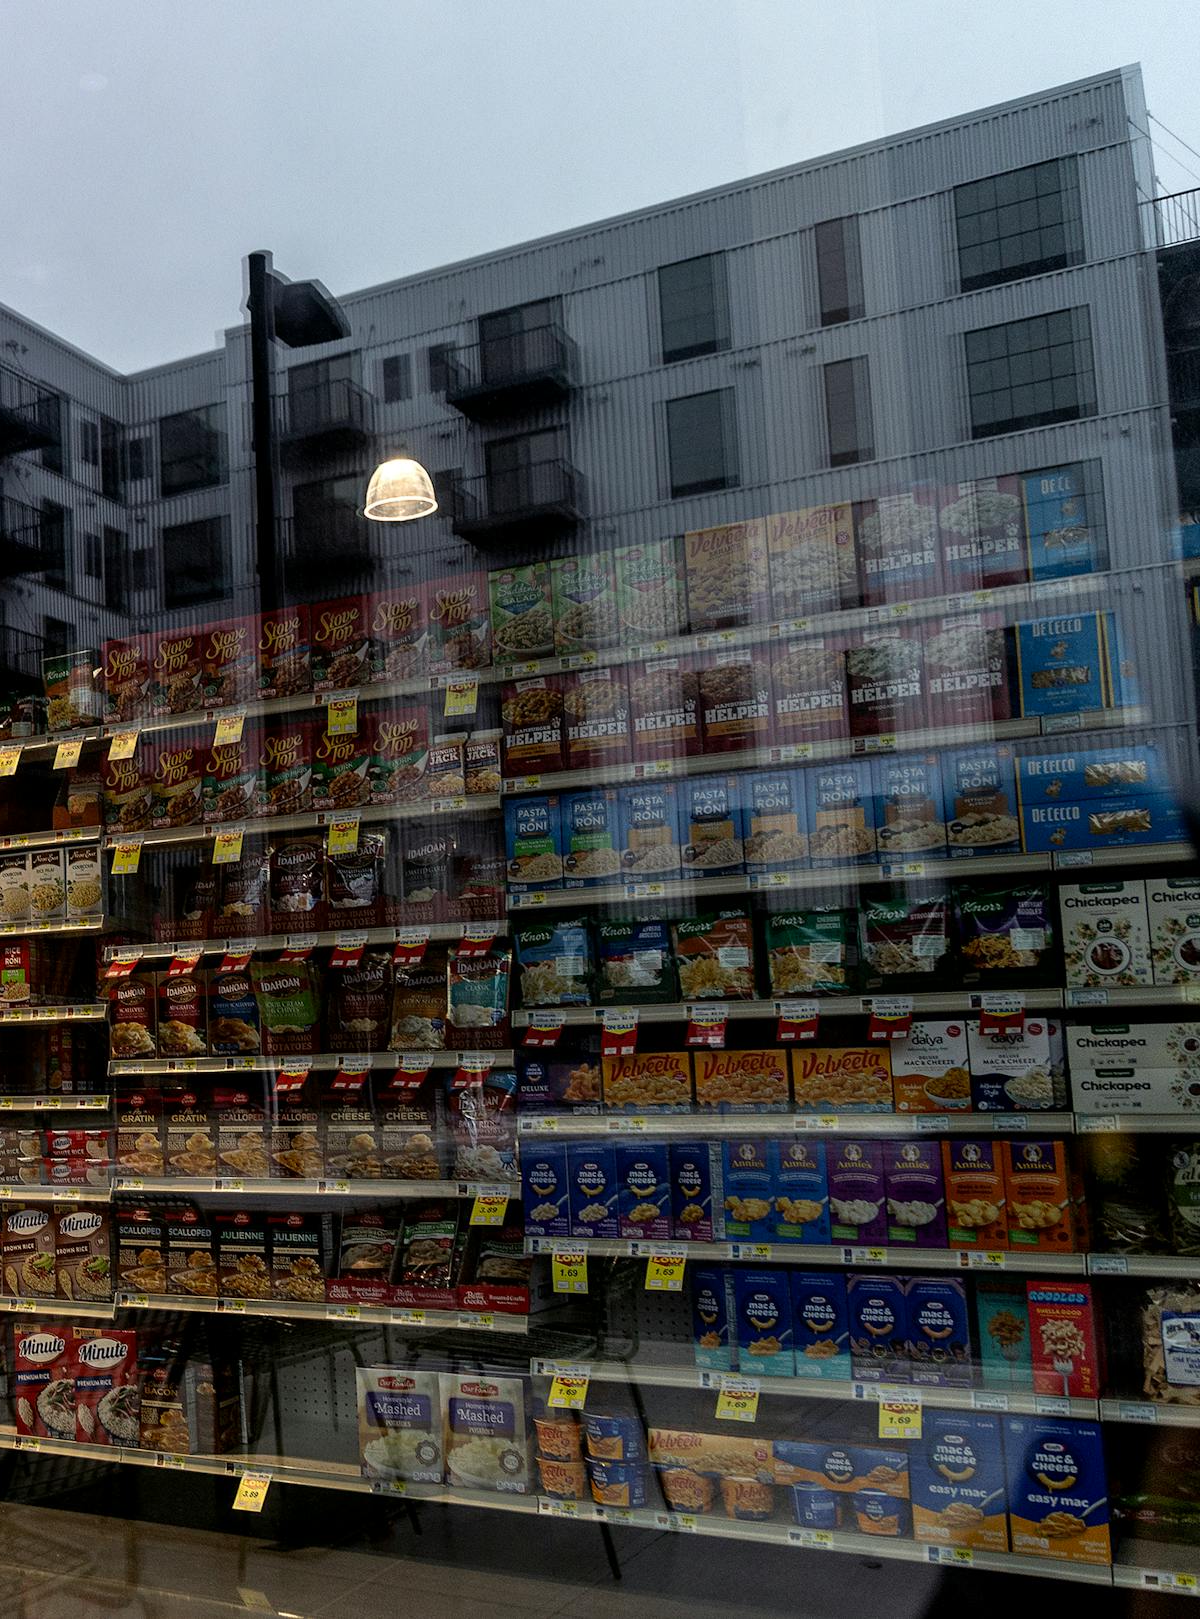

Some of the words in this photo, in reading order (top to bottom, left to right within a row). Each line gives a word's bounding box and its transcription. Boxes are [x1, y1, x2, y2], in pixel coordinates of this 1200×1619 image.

[373, 597, 418, 632] Stove
[315, 607, 360, 642] Stove
[390, 613, 412, 636] Top
[259, 616, 301, 651] Stove
[330, 624, 353, 645] Top
[206, 628, 248, 659] Stove
[274, 633, 295, 654] Top
[154, 637, 194, 669] Stove
[221, 644, 241, 664] Top
[168, 653, 187, 674] Top
[929, 672, 1003, 693] HELPER
[852, 683, 921, 704] HELPER
[776, 694, 843, 714] HELPER
[704, 703, 768, 723] HELPER
[373, 718, 420, 751] Stove
[506, 730, 561, 747] HELPER
[568, 722, 627, 739] HELPER
[260, 734, 303, 765] Stove
[390, 735, 414, 756] Top
[275, 752, 297, 769] Top
[430, 752, 460, 765] JACK
[466, 749, 496, 761] JACK
[155, 749, 194, 779] Stove
[960, 760, 996, 772] PASTA
[169, 765, 188, 784] Top
[694, 788, 725, 801] PASTA
[518, 807, 546, 818] PASTA
[574, 802, 604, 812] PASTA
[277, 851, 317, 866] IDAHOAN
[961, 901, 1004, 915] Knorr
[1064, 895, 1139, 909] Chickapea
[769, 913, 806, 928] Knorr
[866, 908, 907, 923] Knorr
[601, 925, 633, 937] Knorr
[677, 920, 713, 935] Knorr
[520, 931, 552, 943] Knorr
[457, 958, 501, 974] IDAHOAN
[167, 985, 197, 997] IDAHOAN
[261, 977, 300, 992] IDAHOAN
[912, 1035, 943, 1046] daiya
[1077, 1038, 1146, 1049] Chickapea
[610, 1055, 680, 1082] Velveeta
[704, 1052, 777, 1079] Velveeta
[803, 1051, 880, 1079] Velveeta
[1081, 1081, 1151, 1092] Chickapea
[121, 1115, 155, 1124] GRATIN
[331, 1111, 371, 1121] CHEESE
[385, 1111, 427, 1121] CHEESE
[7, 1212, 49, 1233] Minute
[59, 1214, 102, 1235] Minute
[119, 1226, 161, 1235] SCALLOPED
[168, 1228, 212, 1237] SCALLOPED
[220, 1231, 265, 1242] JULIENNE
[273, 1233, 318, 1243] JULIENNE
[19, 1335, 65, 1357] Minute
[78, 1343, 128, 1363] Minute
[374, 1402, 421, 1416] Mashed
[457, 1408, 505, 1424] Mashed
[929, 1484, 958, 1497] easy
[961, 1487, 987, 1498] mac
[1027, 1493, 1058, 1507] easy
[1061, 1498, 1089, 1508] mac
